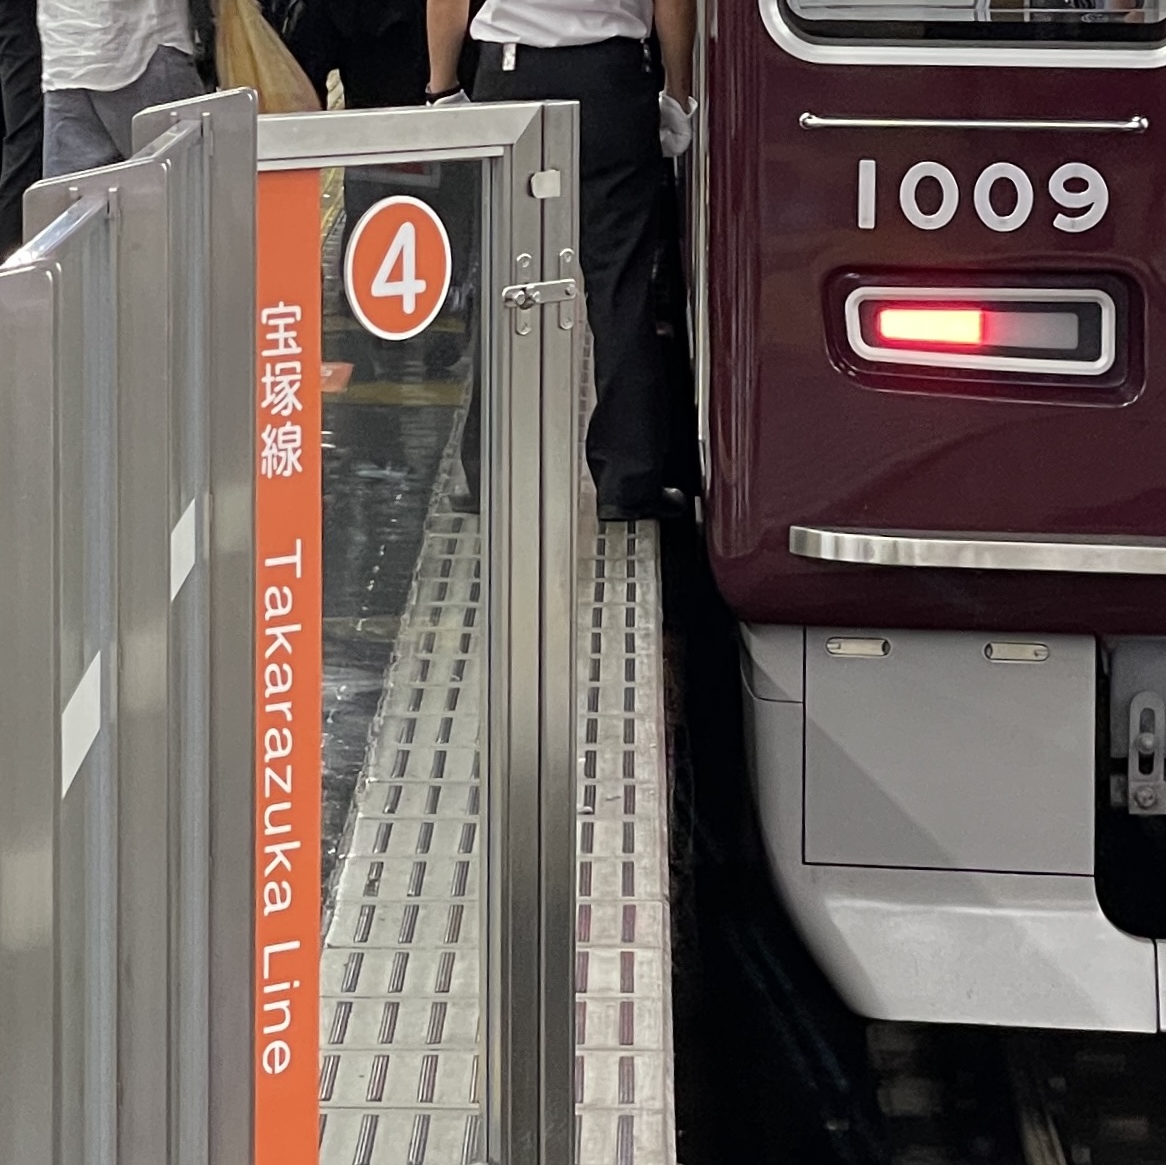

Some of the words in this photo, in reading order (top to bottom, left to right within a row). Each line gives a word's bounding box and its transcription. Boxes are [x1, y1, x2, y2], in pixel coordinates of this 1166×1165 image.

[858, 159, 1109, 232] 1009
[371, 221, 427, 315] 4
[261, 301, 303, 479] 宝塚線
[262, 538, 302, 917] Takarazuka
[261, 940, 301, 1075] Line
